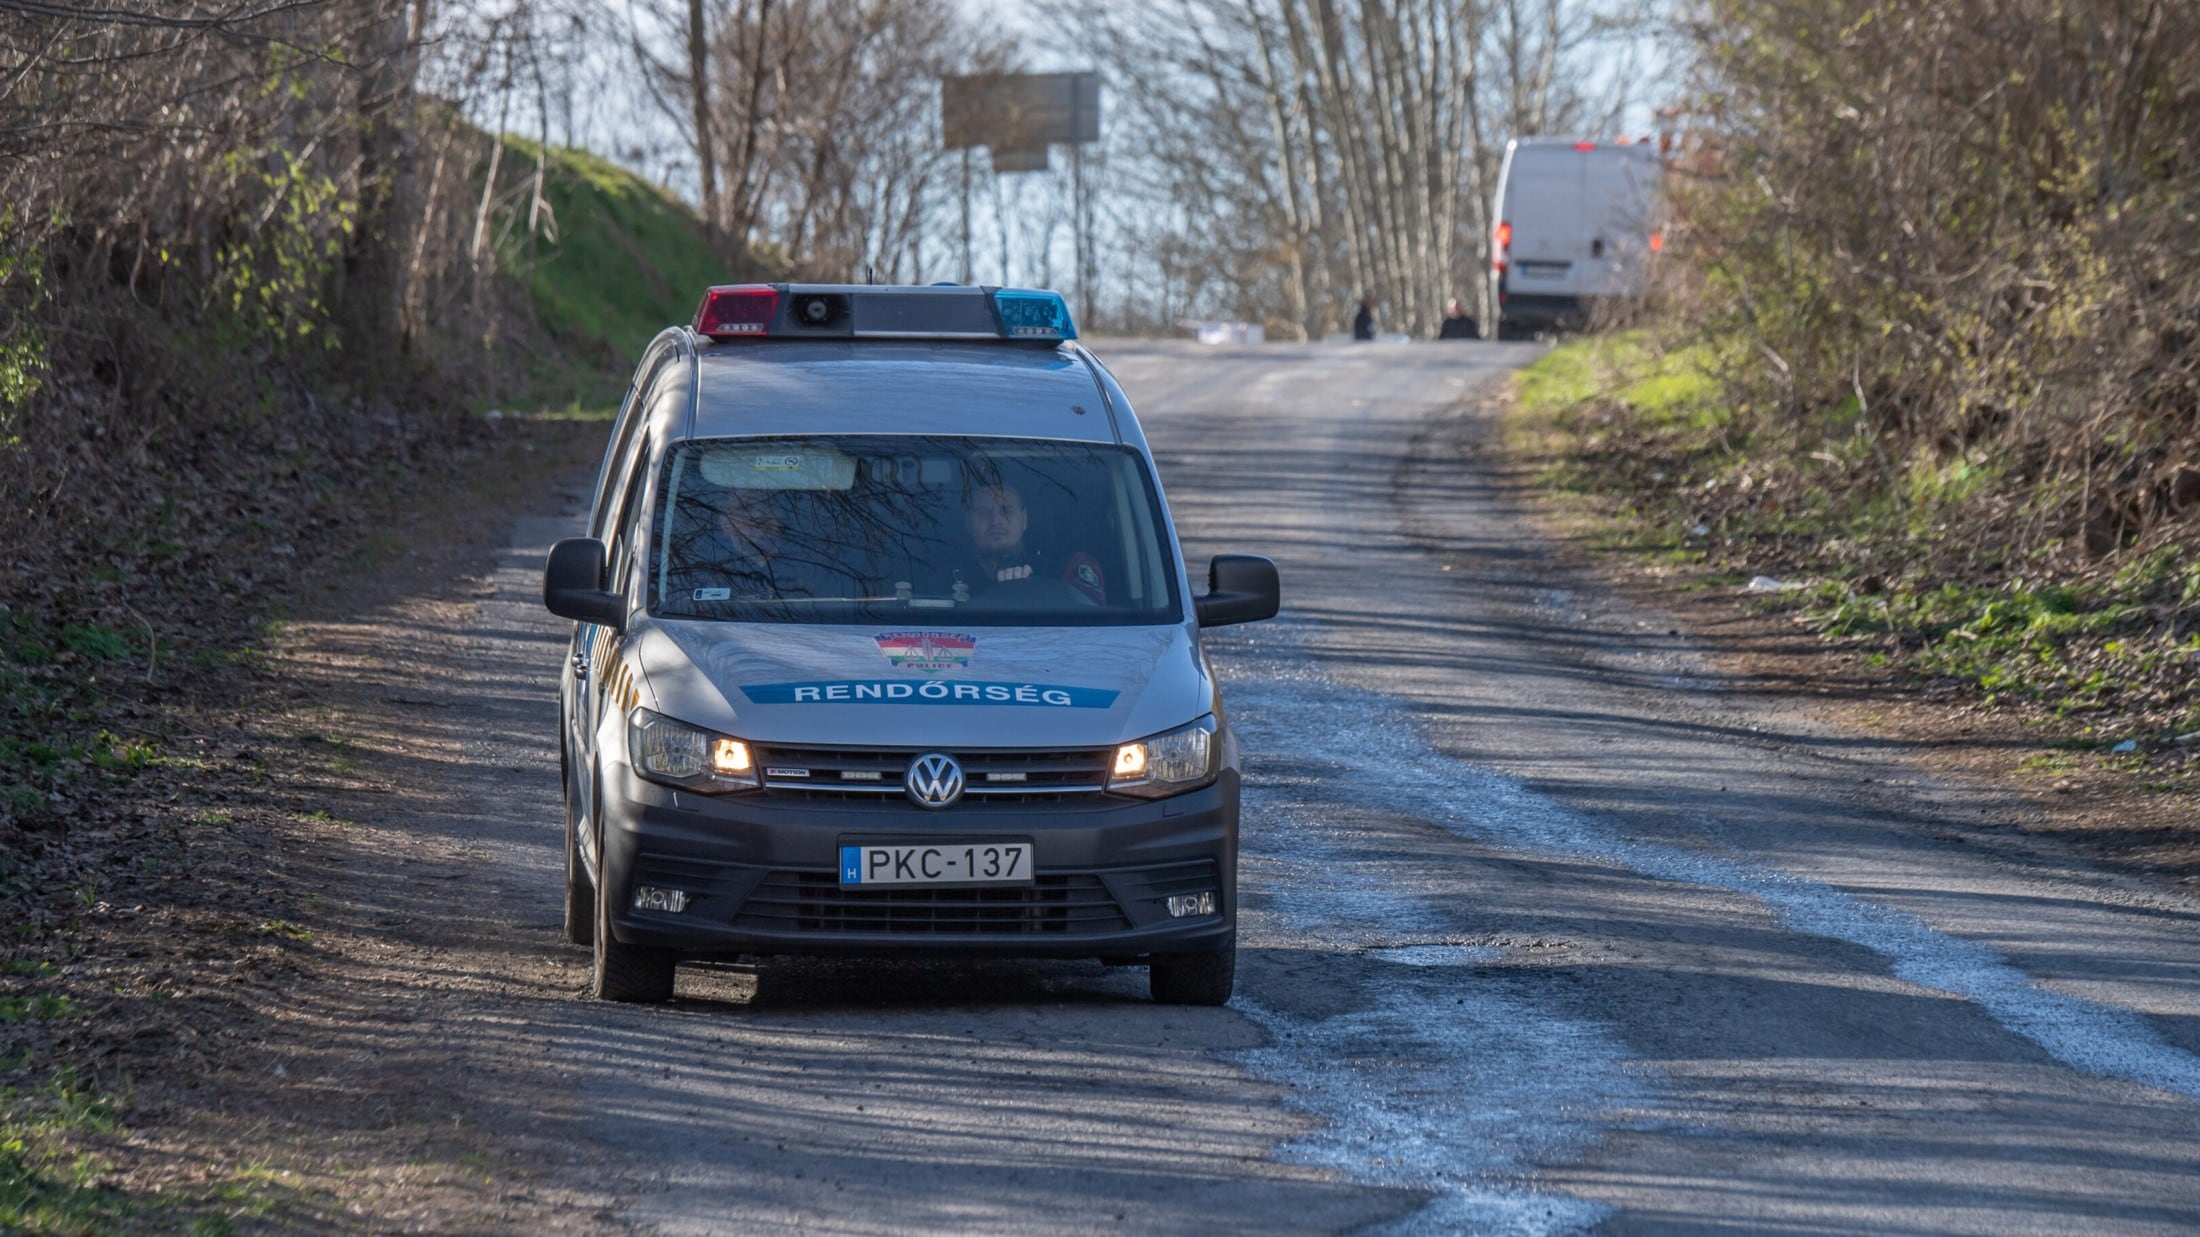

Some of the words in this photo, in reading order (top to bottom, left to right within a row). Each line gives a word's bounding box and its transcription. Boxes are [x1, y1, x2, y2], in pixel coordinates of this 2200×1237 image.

[794, 681, 1072, 706] RENDŐRSÉG
[847, 868, 857, 879] H
[869, 847, 1022, 880] PKC-137
